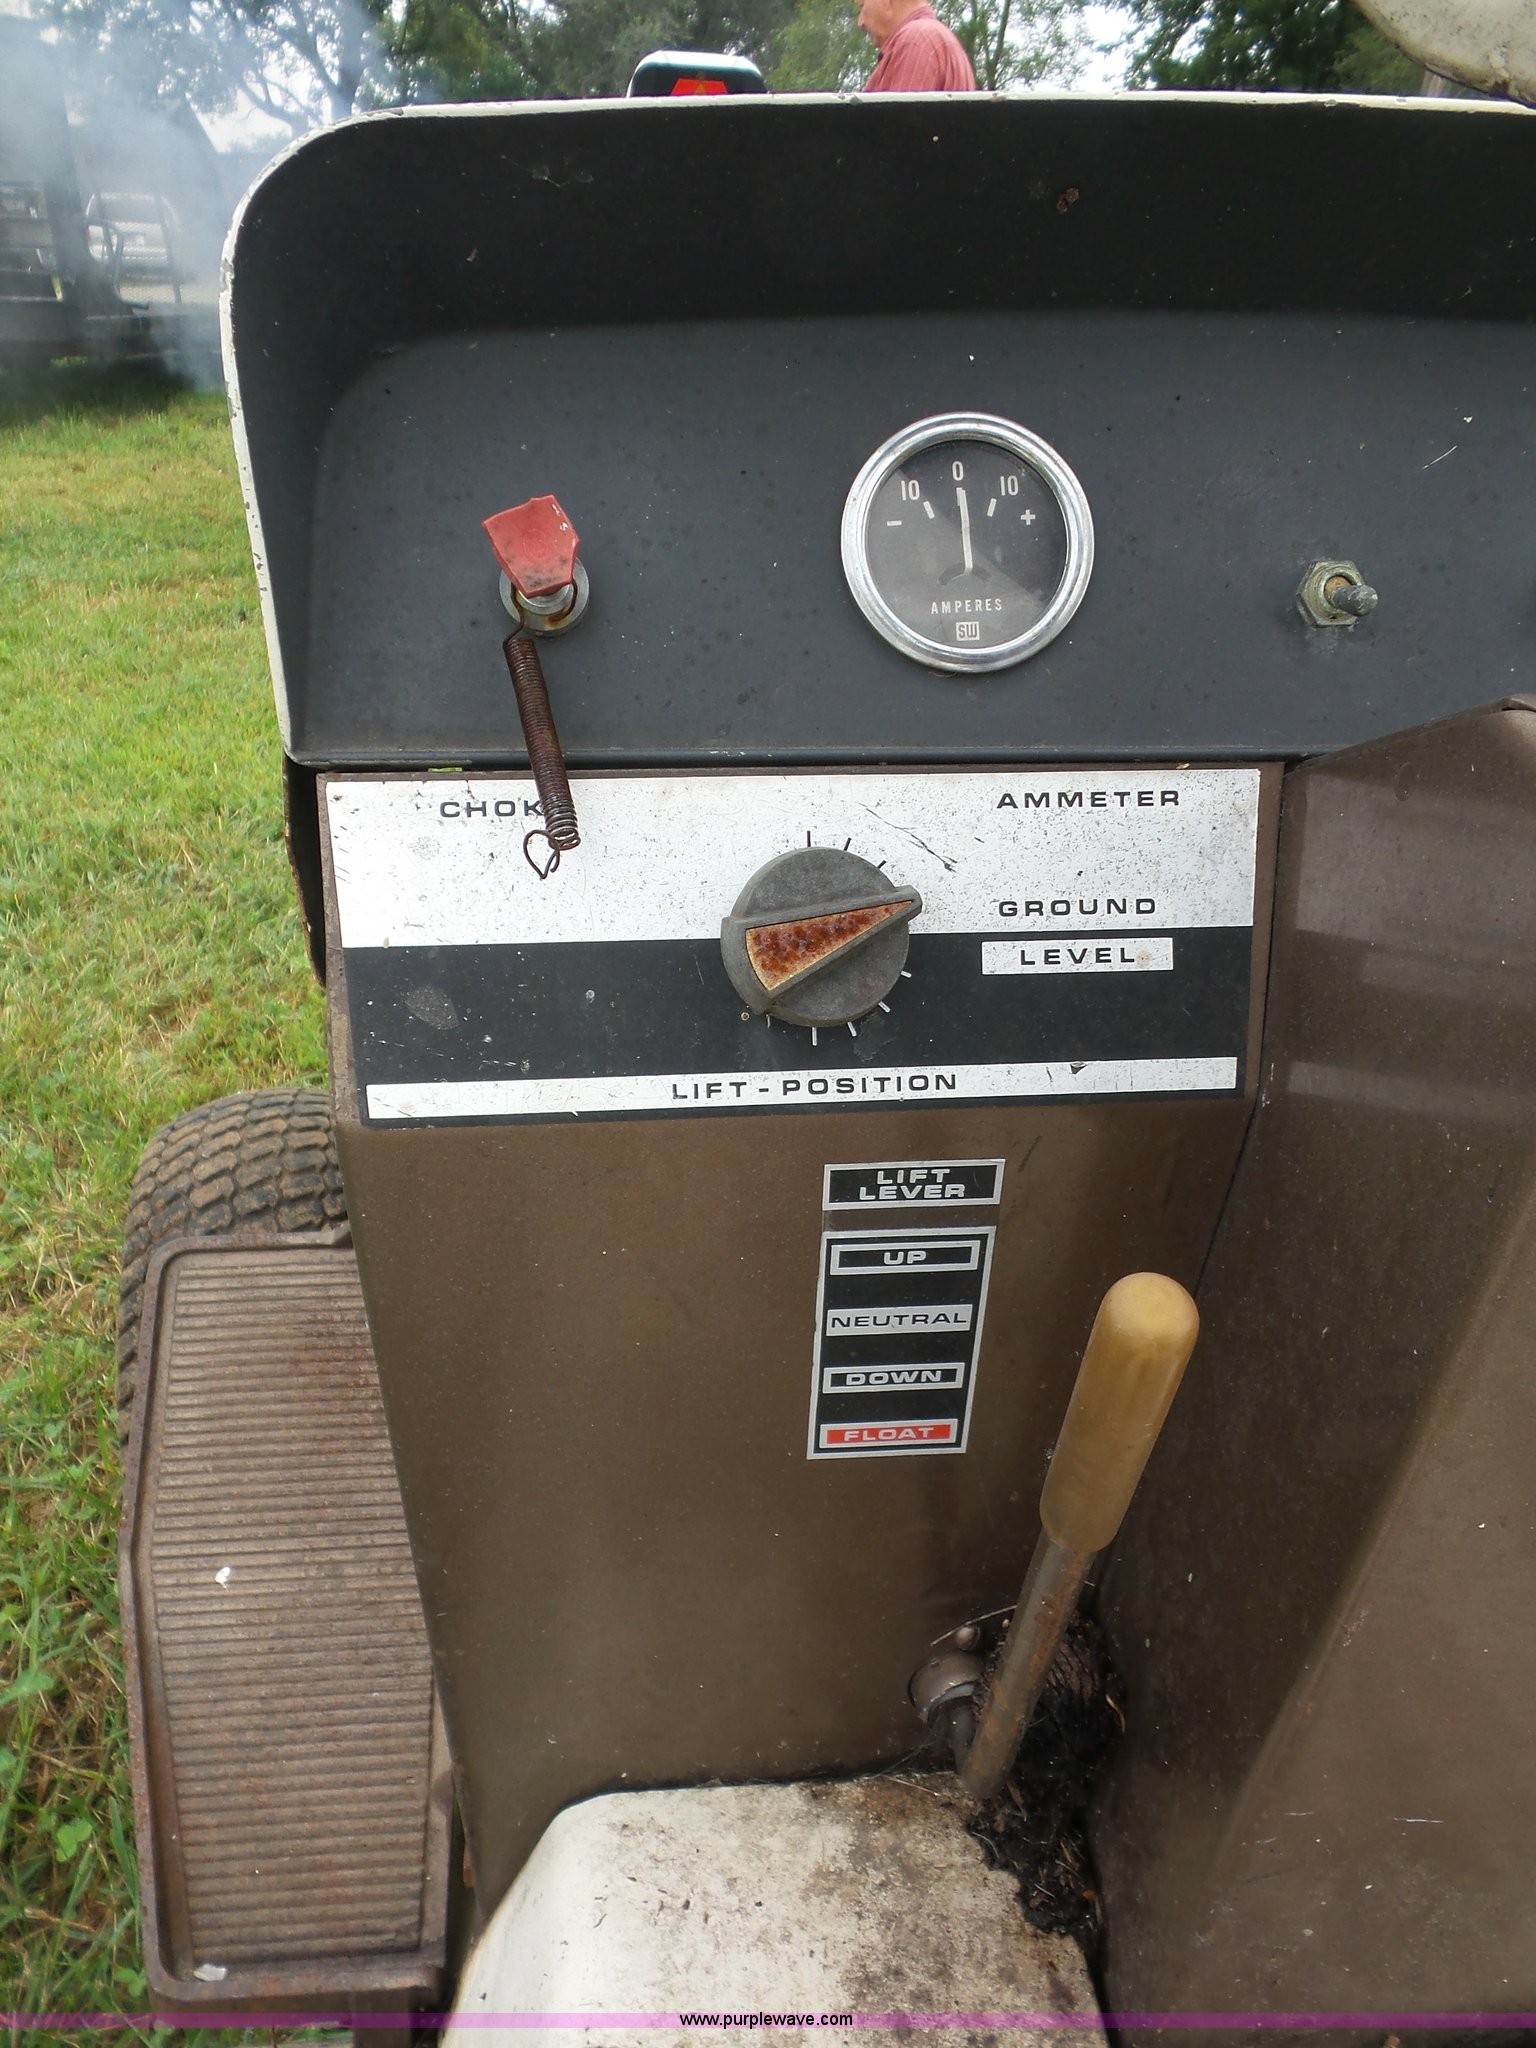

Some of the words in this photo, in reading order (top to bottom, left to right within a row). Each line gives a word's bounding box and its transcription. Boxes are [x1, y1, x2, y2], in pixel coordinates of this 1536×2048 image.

[952, 461, 964, 481] 0
[900, 480, 920, 500] 10
[1000, 476, 1019, 496] 10
[931, 599, 1002, 614] AMPERES
[957, 623, 979, 639] SW
[996, 790, 1180, 809] AMMETER
[440, 800, 546, 818] CHOK
[998, 898, 1156, 917] GROUND
[1020, 947, 1136, 966] LEVEL
[877, 1169, 950, 1184] LIFT
[859, 1184, 965, 1200] LEVER
[883, 1250, 927, 1265] UP
[831, 1312, 967, 1328] NEUTRAL
[845, 1370, 942, 1386] DOWN
[843, 1426, 935, 1442] FLOAT
